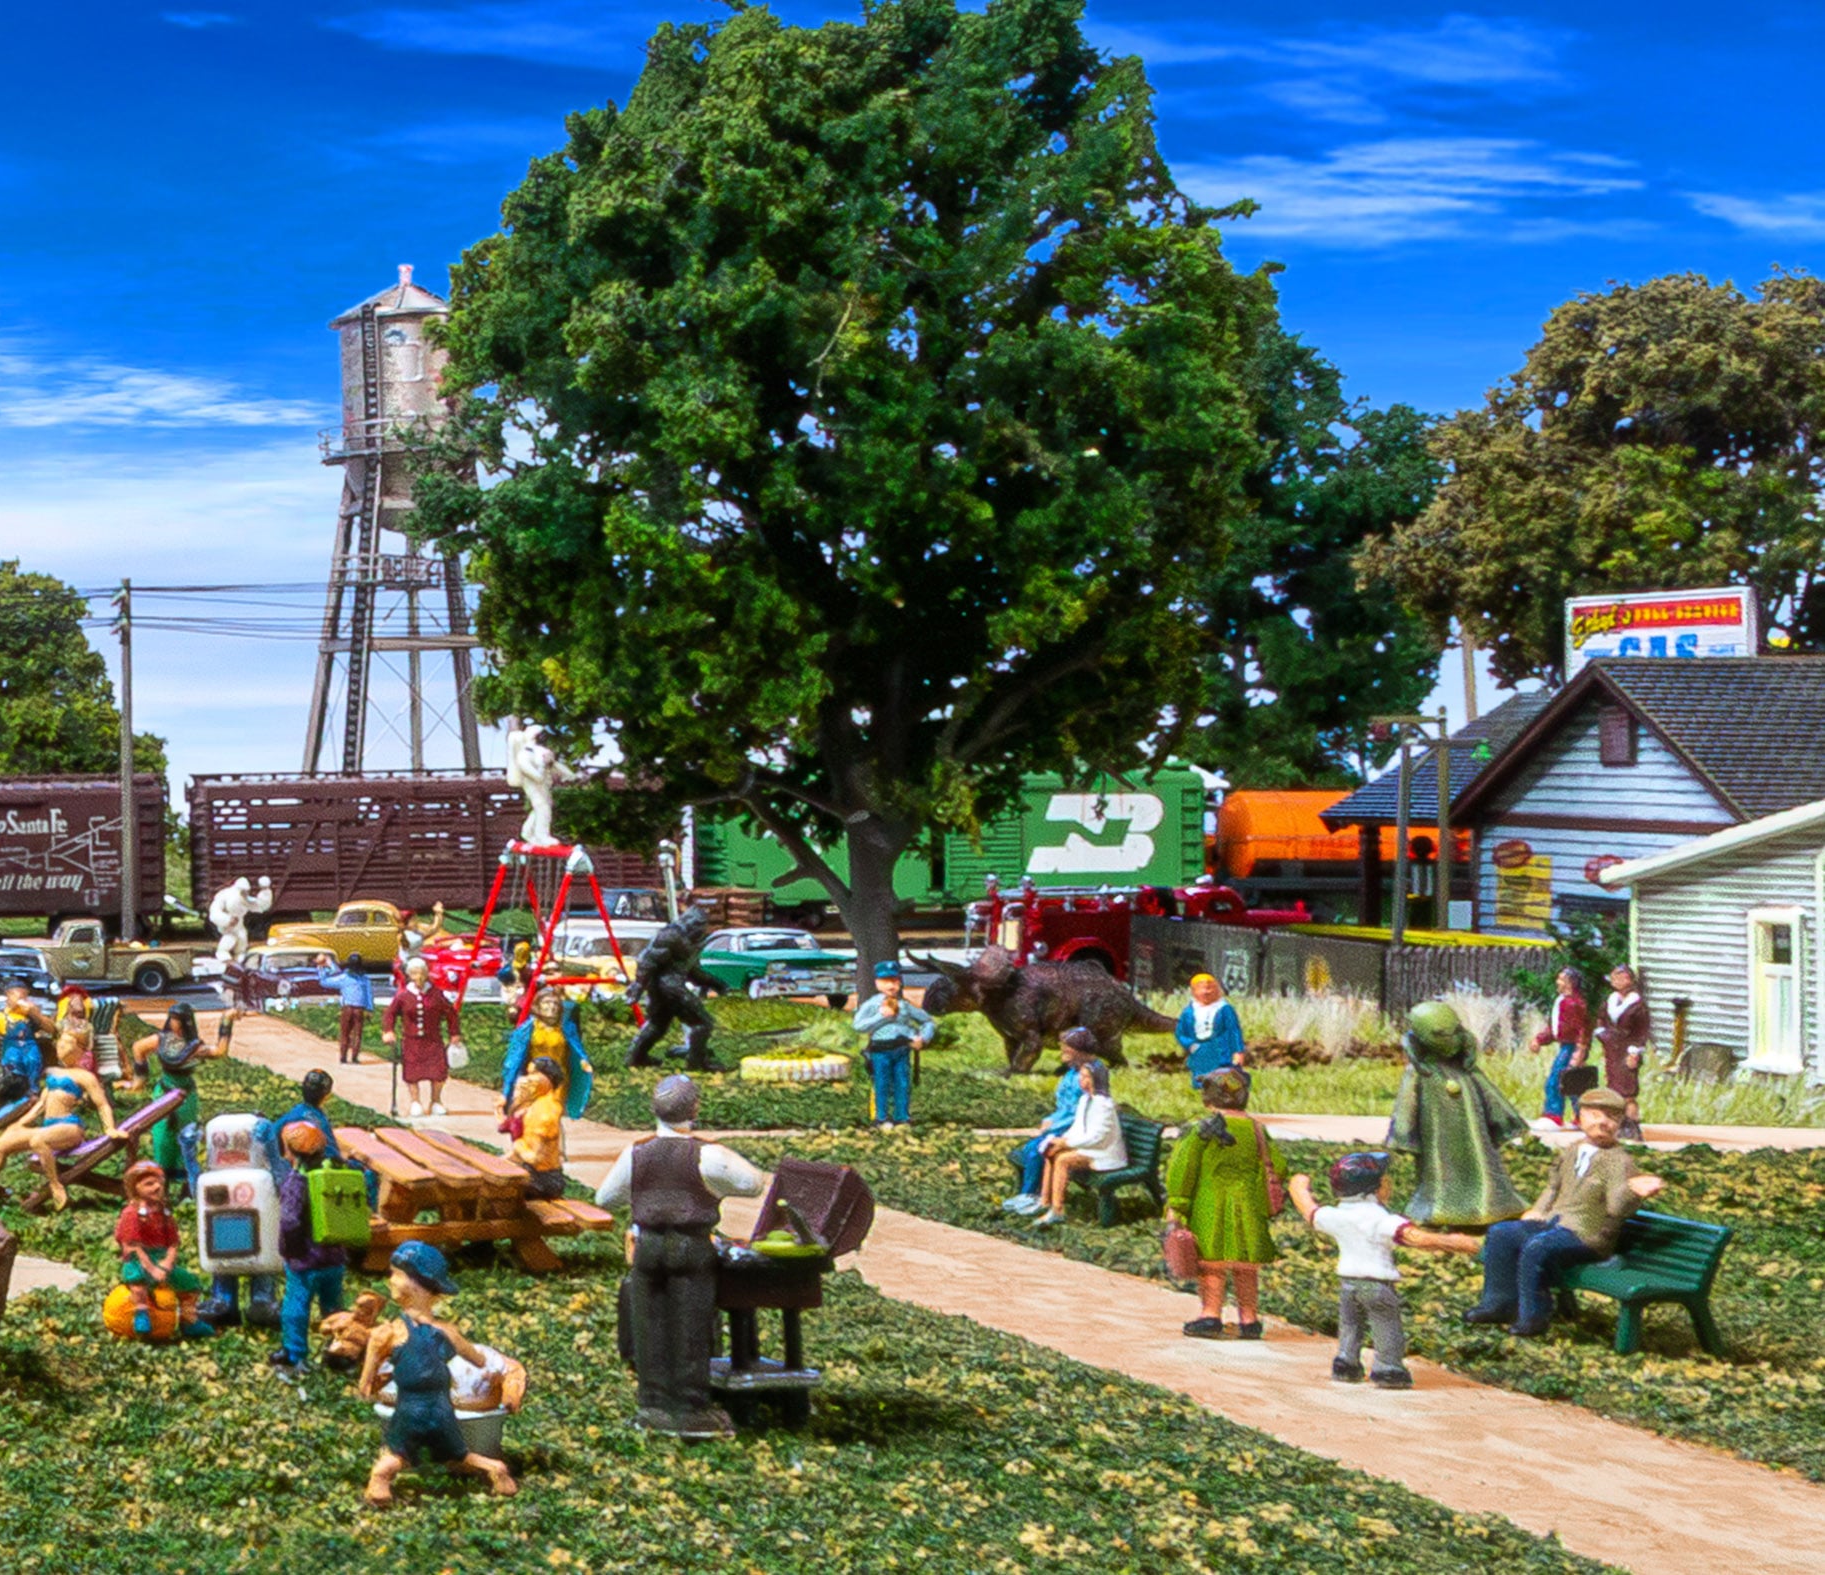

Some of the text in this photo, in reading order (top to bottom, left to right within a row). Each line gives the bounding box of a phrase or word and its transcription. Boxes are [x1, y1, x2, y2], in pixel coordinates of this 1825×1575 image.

[1619, 633, 1698, 658] GAS
[7, 809, 49, 835] Santa
[50, 808, 69, 834] Fe
[16, 873, 42, 891] the
[45, 873, 84, 892] way
